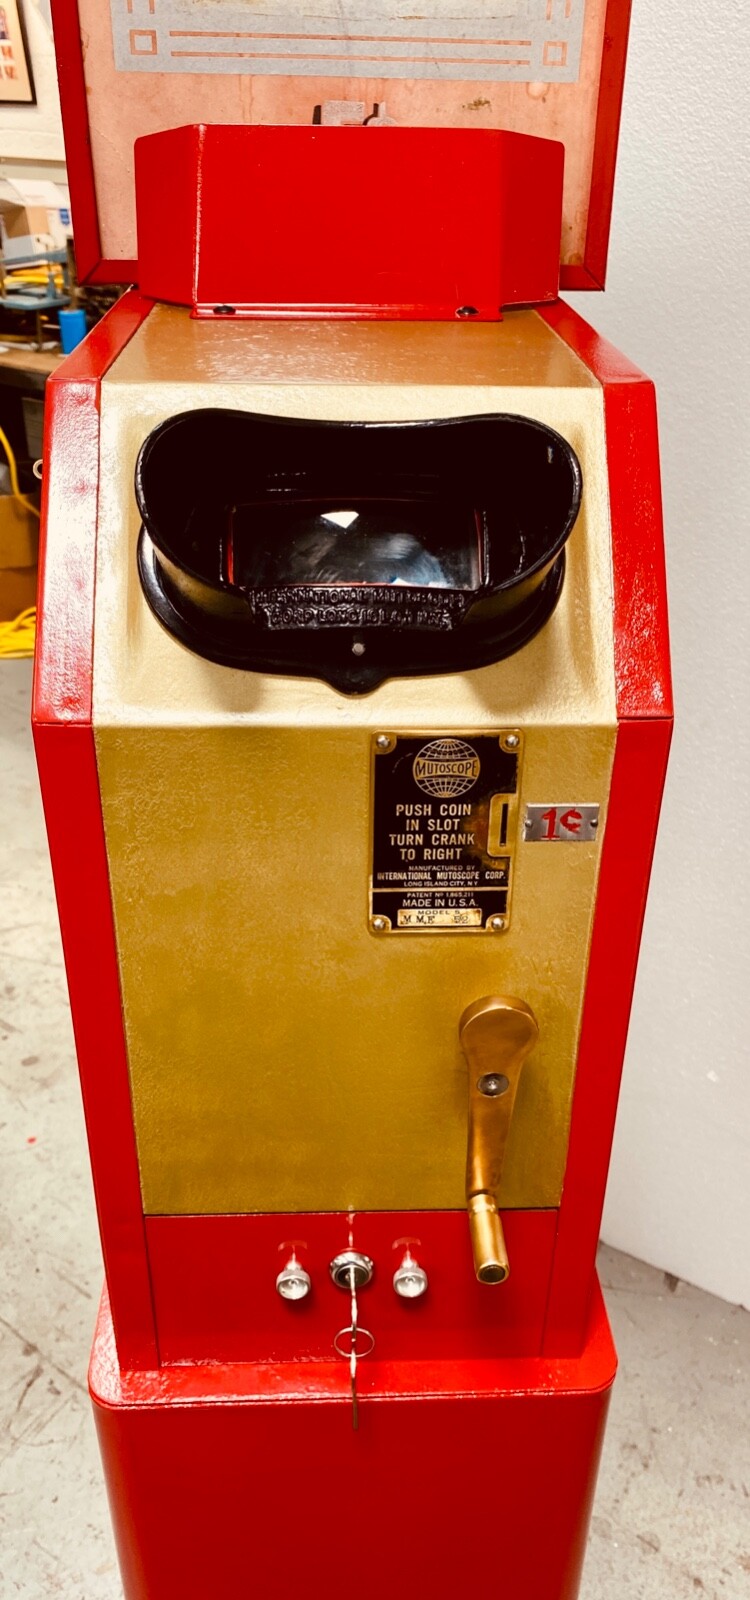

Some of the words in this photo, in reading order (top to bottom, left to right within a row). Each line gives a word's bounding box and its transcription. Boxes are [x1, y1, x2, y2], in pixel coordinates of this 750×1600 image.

[415, 759, 478, 778] MUTOSCOPE
[396, 803, 432, 816] PUSH
[440, 803, 472, 816] COIN
[406, 819, 420, 831] IN
[427, 818, 461, 831] SLOT
[389, 834, 424, 846] TURN
[431, 833, 475, 846] CRANK
[400, 848, 416, 860] TO
[423, 848, 463, 860] RIGHT
[377, 872, 432, 881] INTERNATIONAL
[436, 871, 480, 880] MUTOSCOPE
[484, 871, 507, 880] CORP.
[402, 899, 432, 907] MADE
[434, 898, 446, 907] IN
[448, 898, 479, 907] U.S.A.
